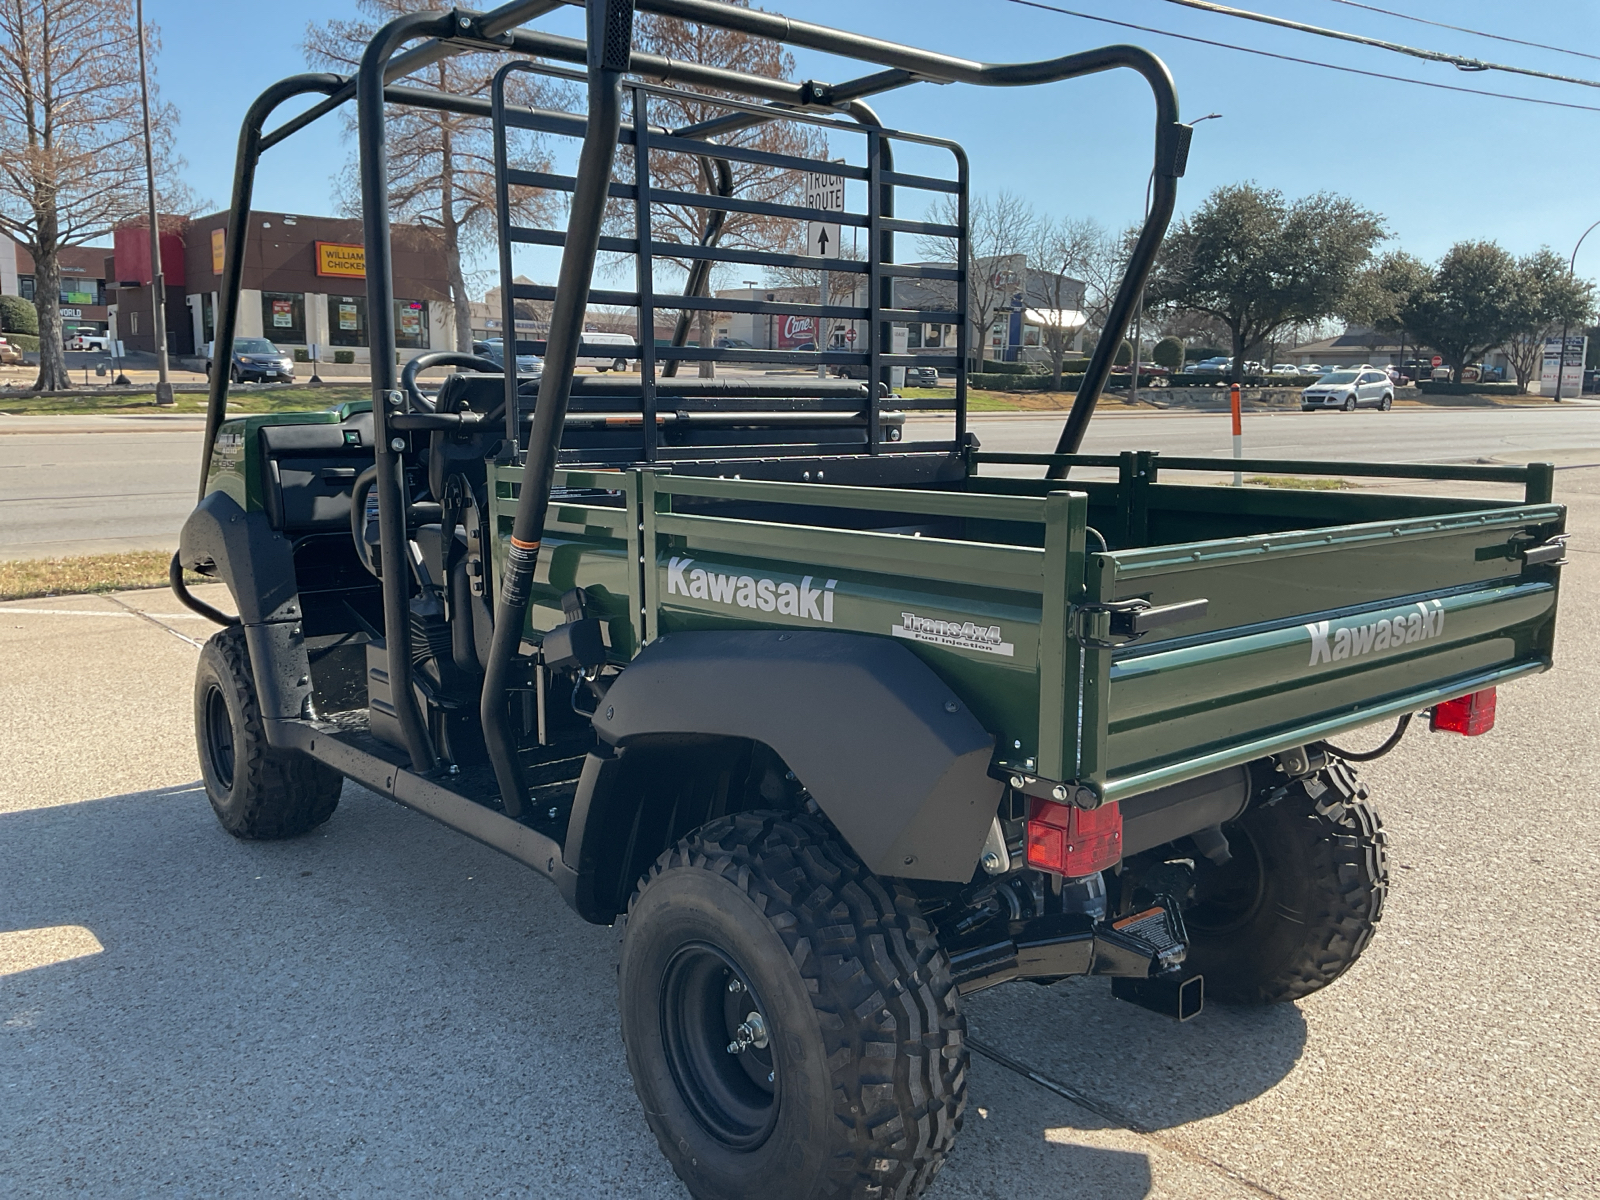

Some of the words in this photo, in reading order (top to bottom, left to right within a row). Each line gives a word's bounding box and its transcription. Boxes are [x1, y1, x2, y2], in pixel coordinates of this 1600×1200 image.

[809, 189, 842, 210] ROUTE
[325, 250, 365, 260] WILLIAM
[667, 556, 838, 623] Kawasaki
[901, 612, 1002, 645] Trans4x4
[915, 633, 938, 642] Fuel
[941, 638, 993, 651] Injection
[1304, 599, 1445, 667] Kawasaki
